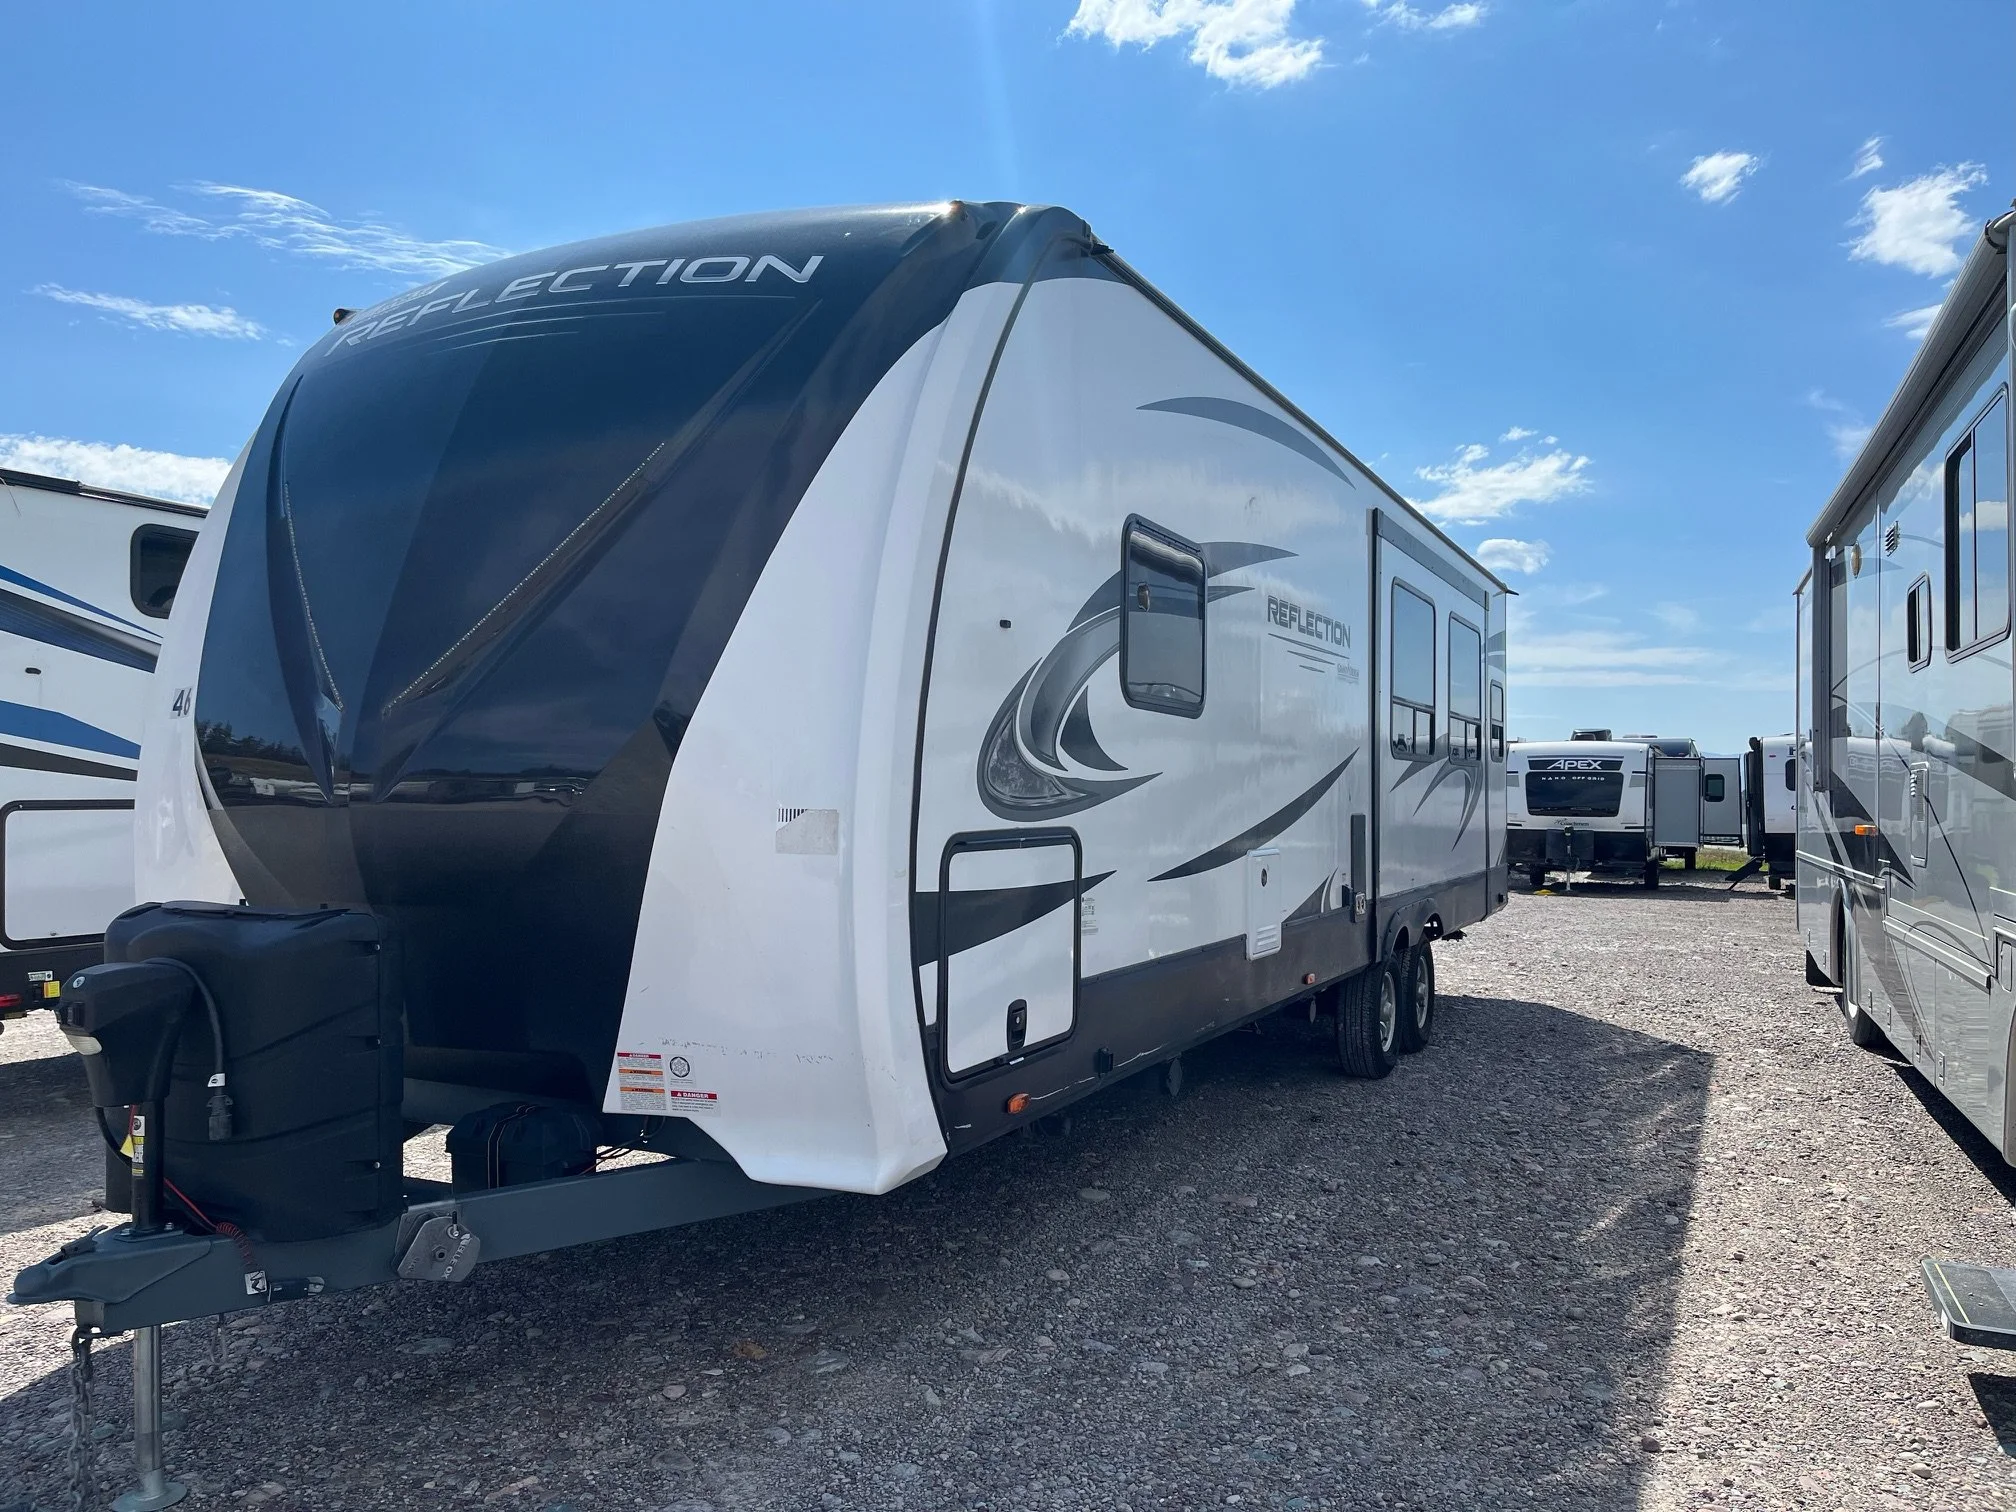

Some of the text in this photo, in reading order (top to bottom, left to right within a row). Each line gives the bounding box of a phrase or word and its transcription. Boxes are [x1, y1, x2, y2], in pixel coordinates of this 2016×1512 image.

[324, 254, 825, 357] REFLECTION
[1267, 594, 1351, 649] REFLECTION
[172, 687, 192, 717] 46
[1546, 759, 1602, 770] APEX
[441, 1266, 453, 1279] OX
